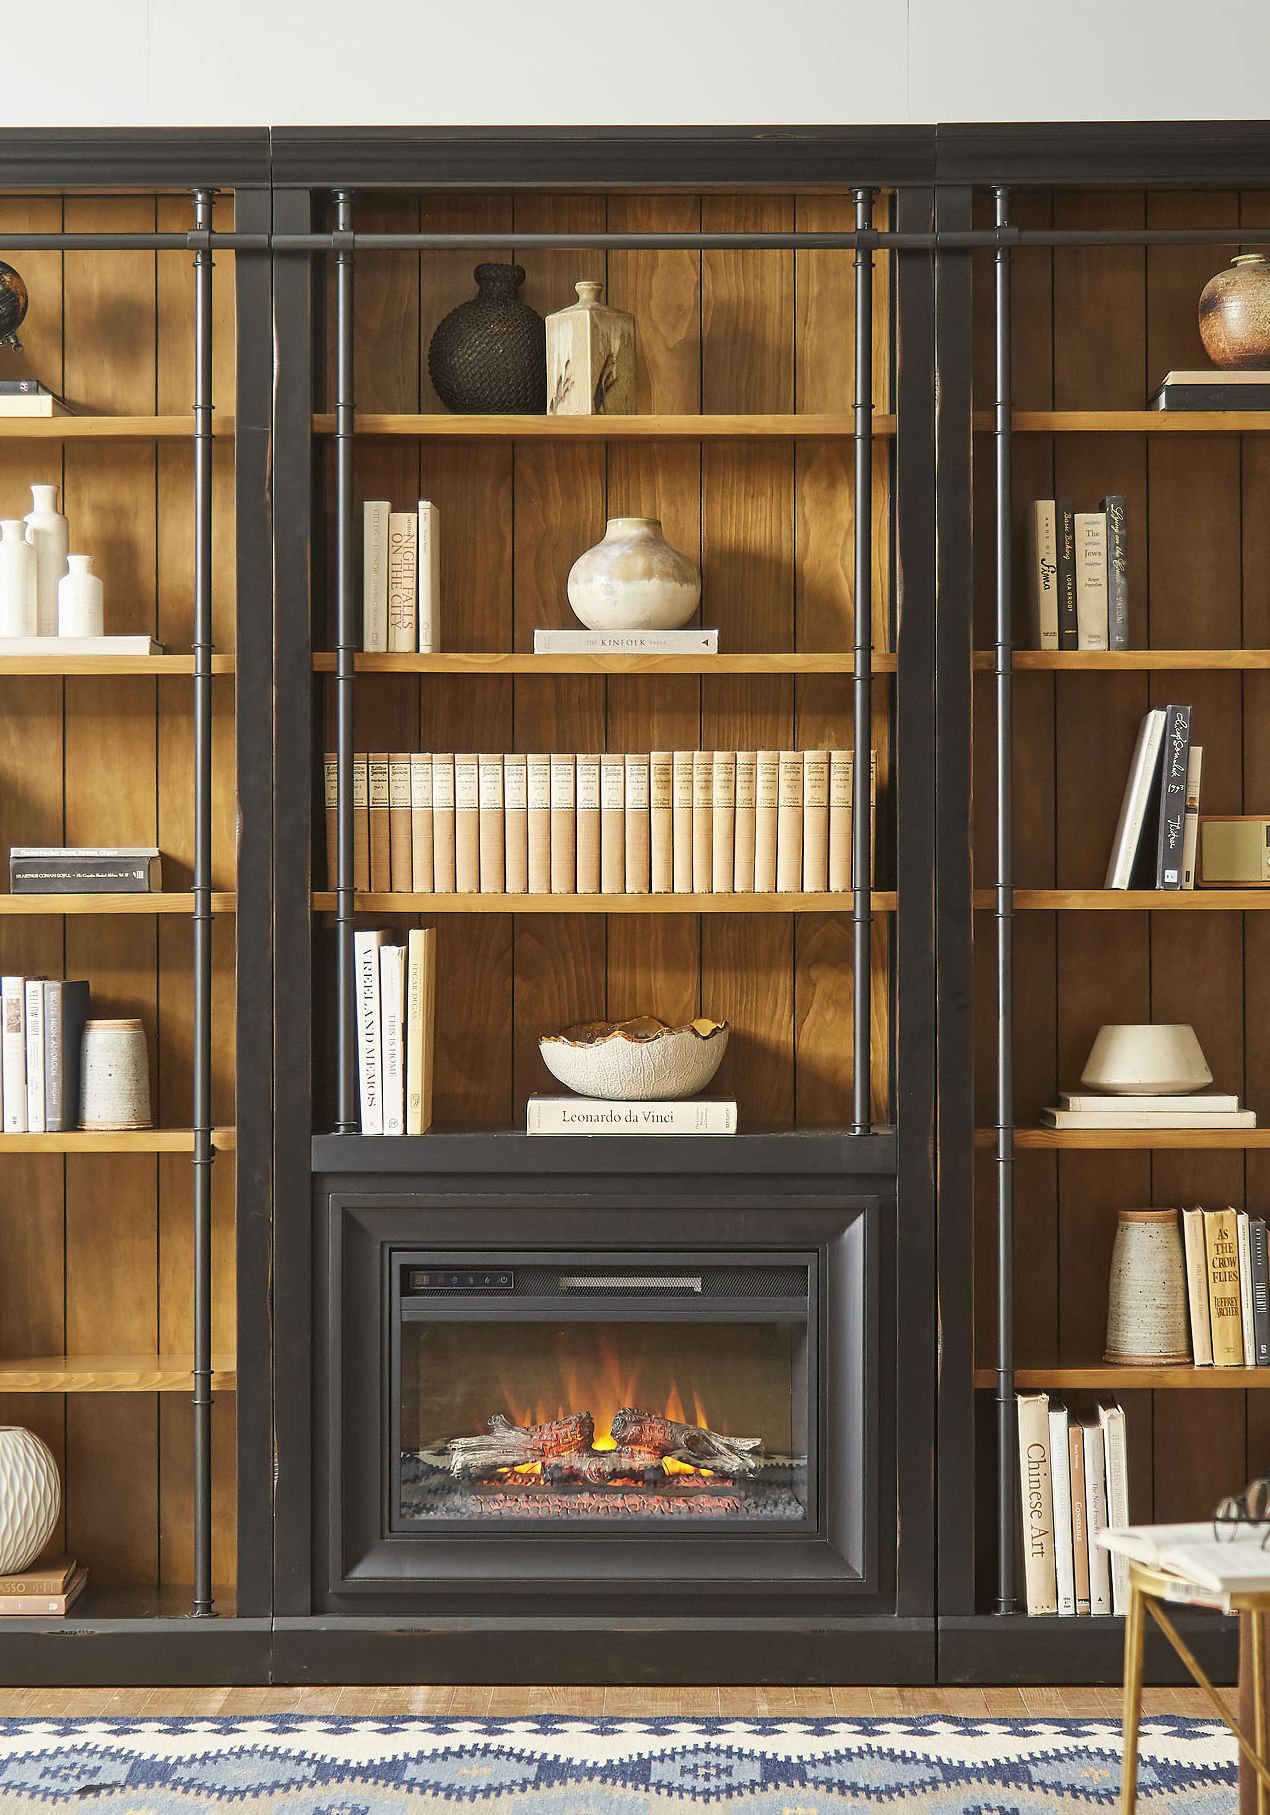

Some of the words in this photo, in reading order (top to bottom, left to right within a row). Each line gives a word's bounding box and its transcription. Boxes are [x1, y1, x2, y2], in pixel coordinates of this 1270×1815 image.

[1111, 504, 1124, 533] Lying
[391, 533, 403, 555] ON
[1062, 533, 1072, 560] Baking
[1085, 549, 1102, 558] Jews
[1115, 546, 1123, 557] the
[403, 534, 415, 582] NIGHT
[391, 560, 402, 590] THE
[390, 594, 402, 631] CITY
[402, 587, 414, 629] FALLS
[362, 949, 376, 1043] VREELAND
[388, 1013, 397, 1036] THIS
[389, 1038, 397, 1047] IS
[389, 1049, 397, 1078] HOME
[365, 1047, 377, 1107] MEMOS
[562, 1110, 621, 1123] Leonardo
[624, 1110, 639, 1123] da
[642, 1111, 674, 1123] Vinci
[1217, 1228, 1229, 1240] AS
[1214, 1242, 1234, 1255] THE
[1212, 1256, 1237, 1269] CROW
[1212, 1270, 1239, 1284] FLIES
[1214, 1296, 1239, 1308] JEFFREY
[1215, 1306, 1240, 1318] ARCHER
[1027, 1443, 1047, 1519] Chinese
[1092, 1495, 1100, 1509] New
[1075, 1501, 1083, 1541] CONSTABLE
[1093, 1510, 1101, 1532] French
[1030, 1524, 1050, 1558] Art
